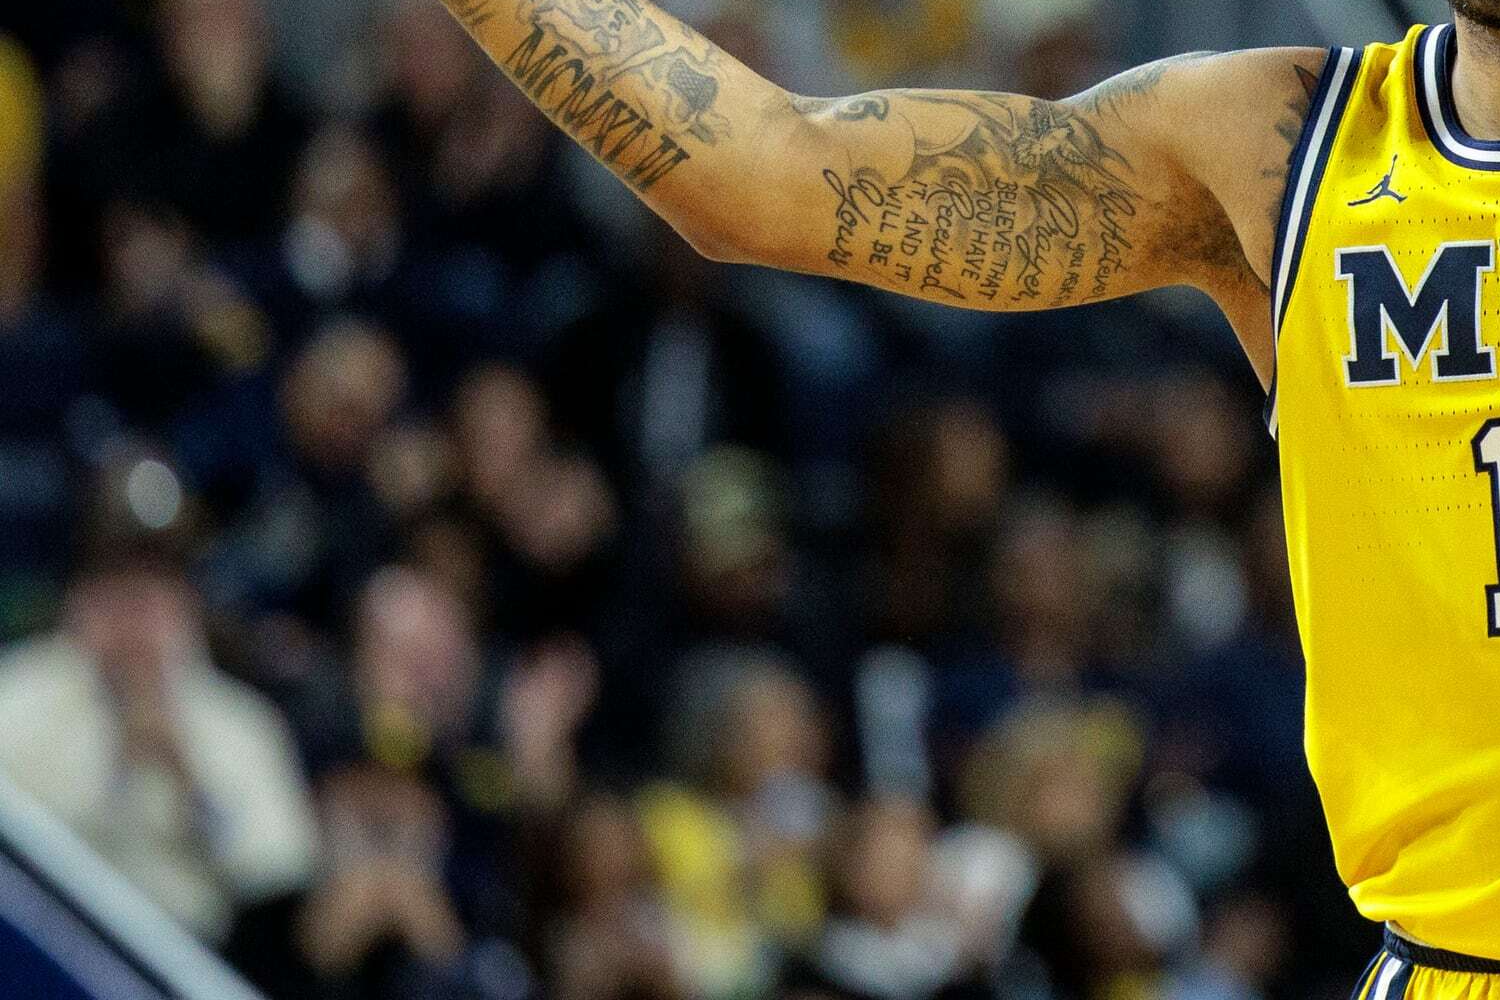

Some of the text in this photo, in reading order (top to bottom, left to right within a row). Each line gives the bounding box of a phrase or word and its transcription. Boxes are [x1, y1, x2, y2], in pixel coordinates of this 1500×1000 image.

[868, 184, 904, 267] WILL BE
[899, 211, 924, 256] AND
[920, 178, 975, 299] Received
[961, 188, 996, 281] YOU HAVE
[978, 178, 1018, 302] BELIEVE THAT
